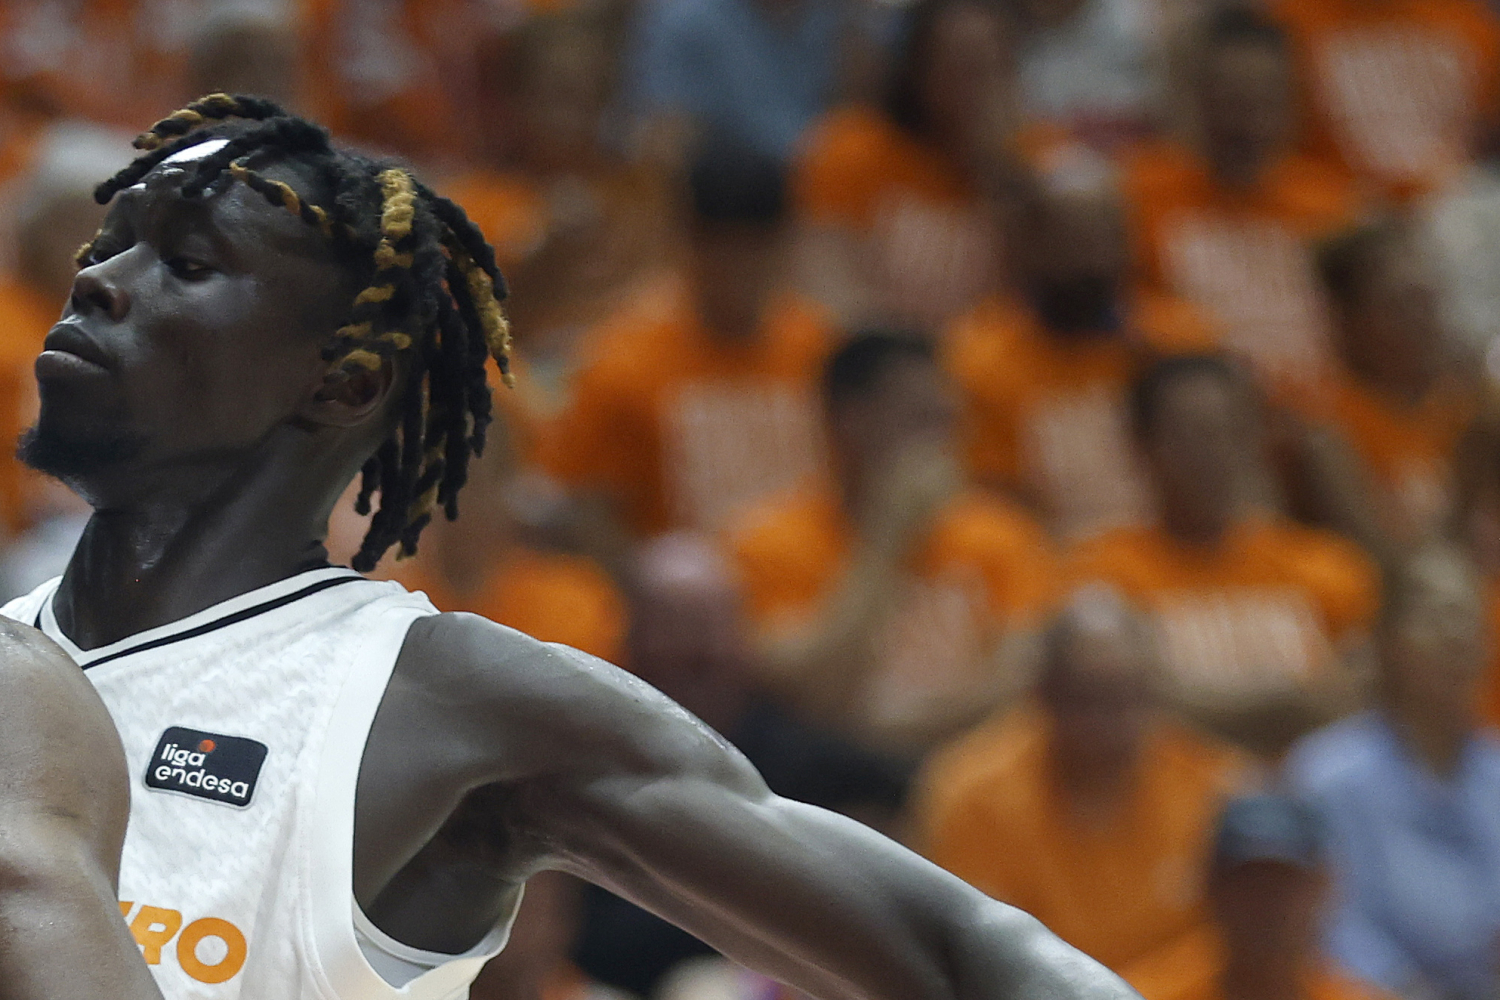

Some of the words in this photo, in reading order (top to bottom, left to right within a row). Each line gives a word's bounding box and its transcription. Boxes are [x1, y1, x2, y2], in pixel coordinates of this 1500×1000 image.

[161, 742, 206, 767] liga
[155, 764, 249, 798] endesa
[118, 900, 248, 984] RO
